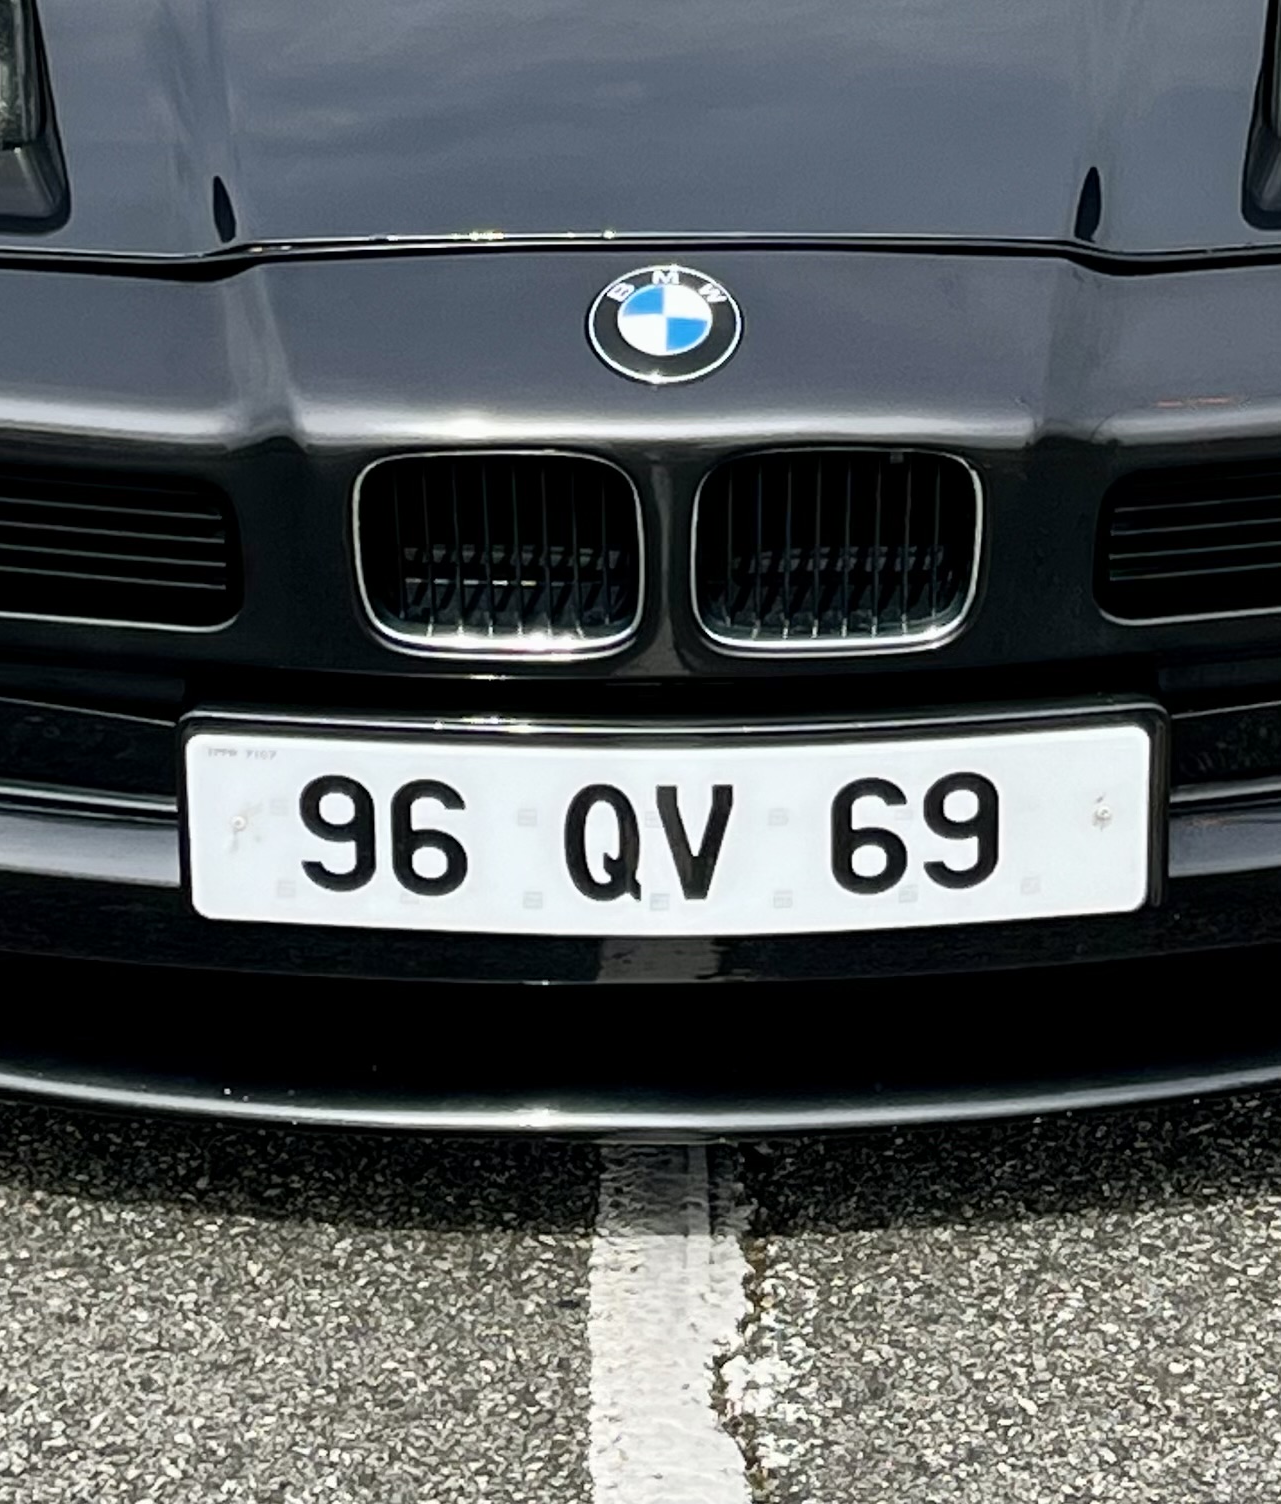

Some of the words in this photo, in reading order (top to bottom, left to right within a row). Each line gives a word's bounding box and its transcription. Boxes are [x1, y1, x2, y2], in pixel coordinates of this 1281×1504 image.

[606, 269, 728, 303] BMW
[299, 774, 468, 897] 96
[564, 783, 734, 902] QV
[831, 771, 1000, 895] 69
